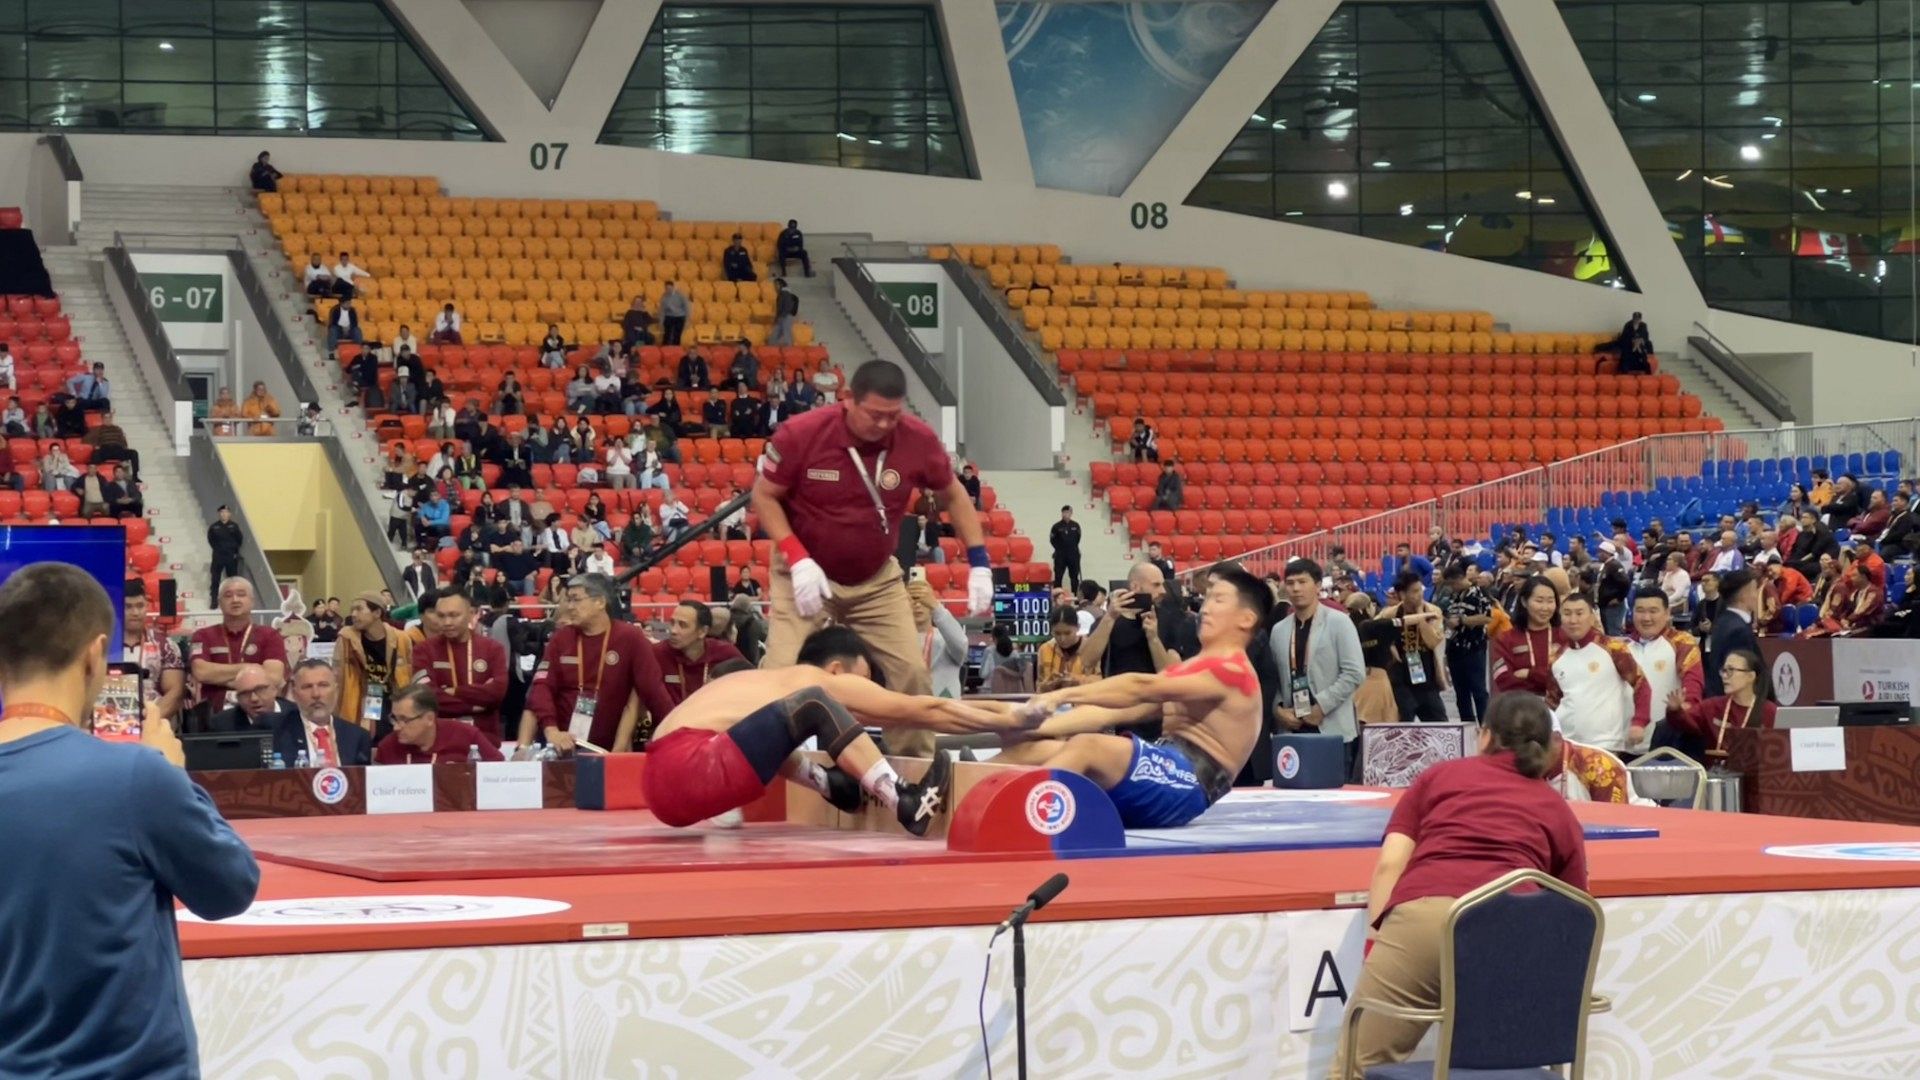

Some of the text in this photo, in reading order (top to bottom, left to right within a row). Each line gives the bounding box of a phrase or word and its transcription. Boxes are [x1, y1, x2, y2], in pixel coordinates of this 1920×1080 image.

[530, 142, 569, 170] 07
[1130, 201, 1168, 230] 08
[186, 286, 217, 309] 07
[907, 295, 934, 315] 08
[1013, 598, 1050, 614] 1000
[1013, 620, 1051, 636] 1000
[1877, 680, 1910, 691] TURKISH
[372, 786, 426, 796] Chief referee
[1304, 950, 1348, 1017] A
